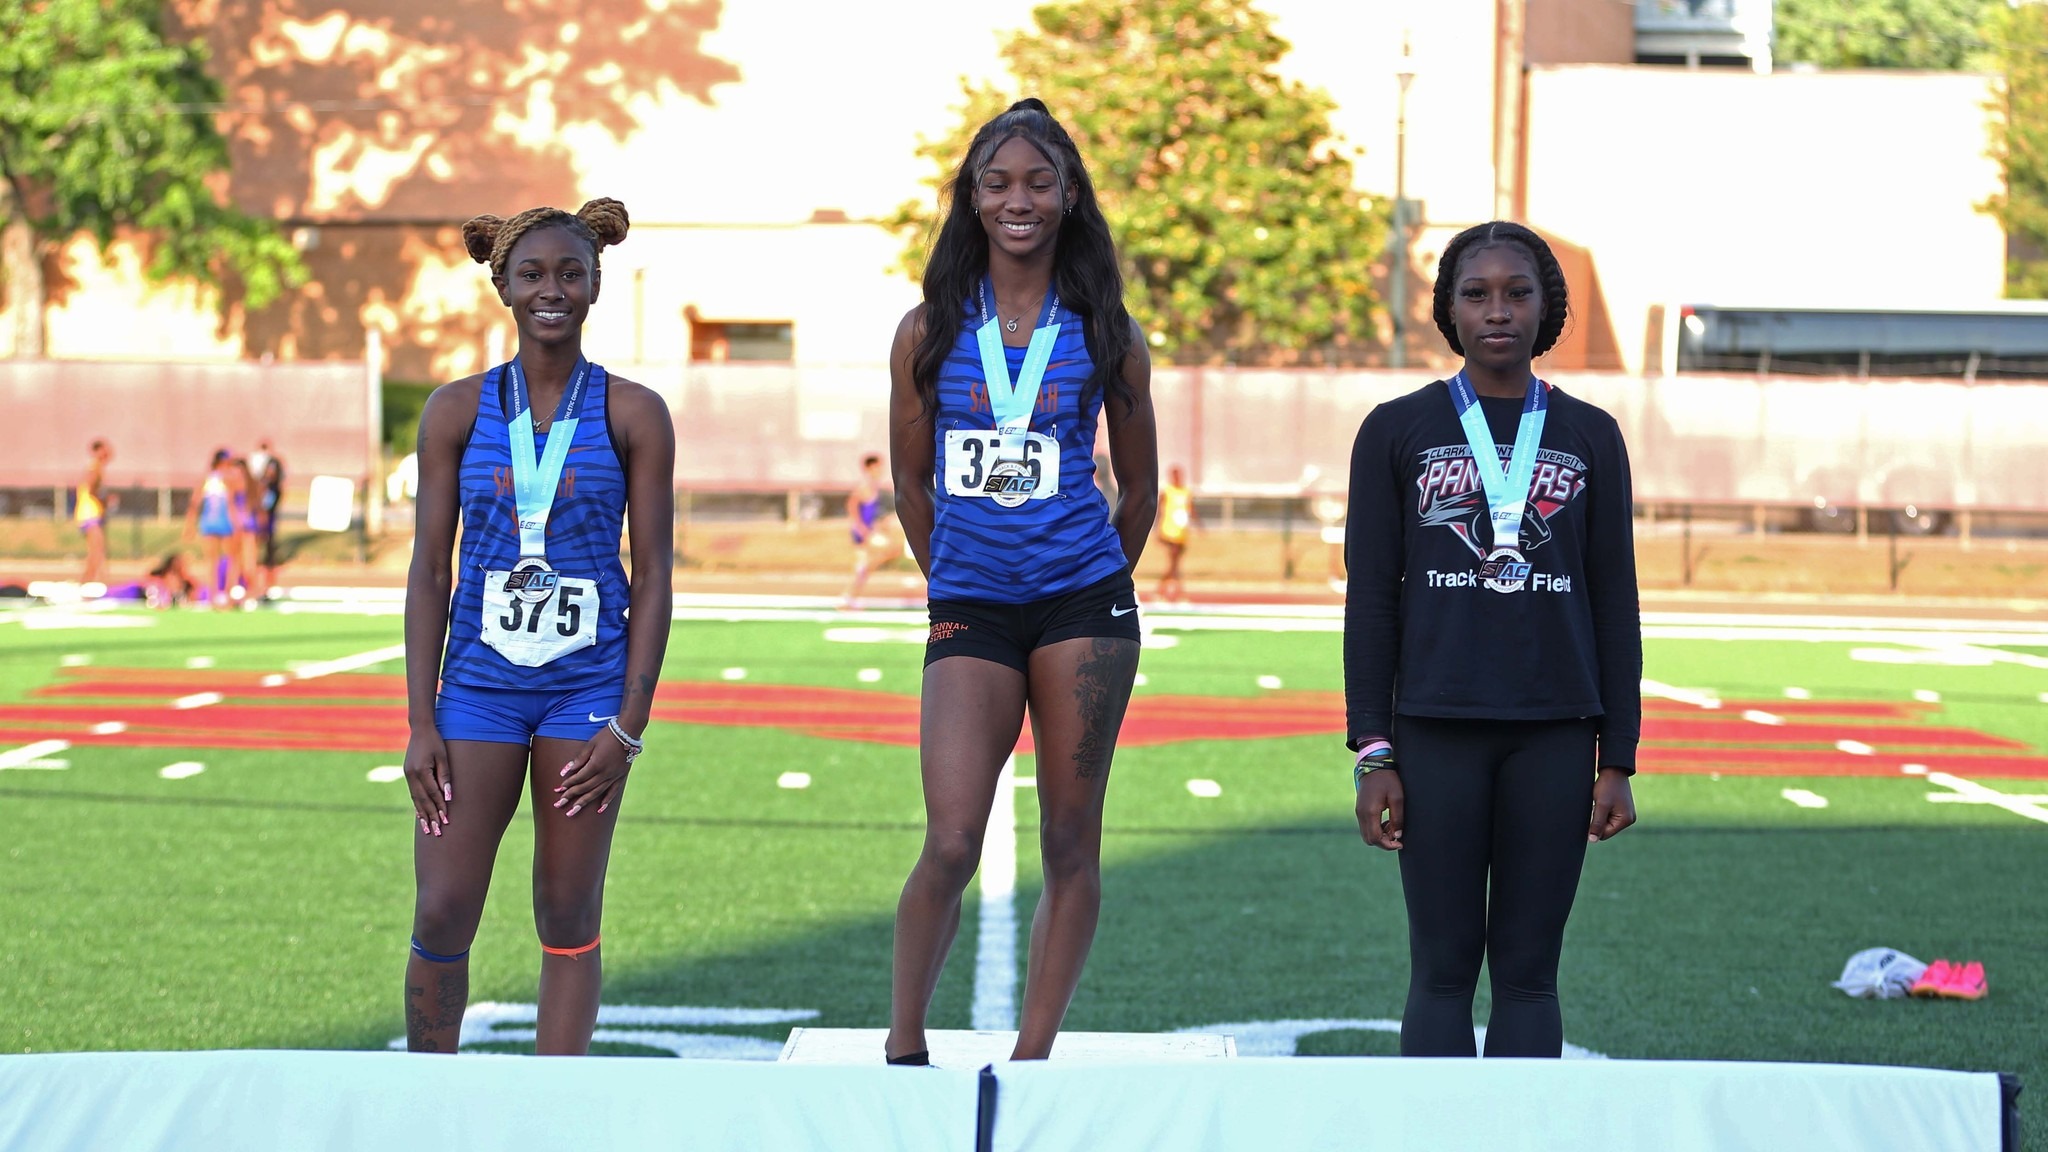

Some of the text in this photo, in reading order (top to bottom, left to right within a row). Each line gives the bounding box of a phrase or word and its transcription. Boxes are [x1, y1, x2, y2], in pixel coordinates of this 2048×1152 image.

[1430, 446, 1467, 459] CLARK
[985, 477, 1034, 491] SIAC
[1481, 563, 1530, 578] SIAC
[507, 573, 556, 587] SIAC
[1427, 569, 1477, 588] Track
